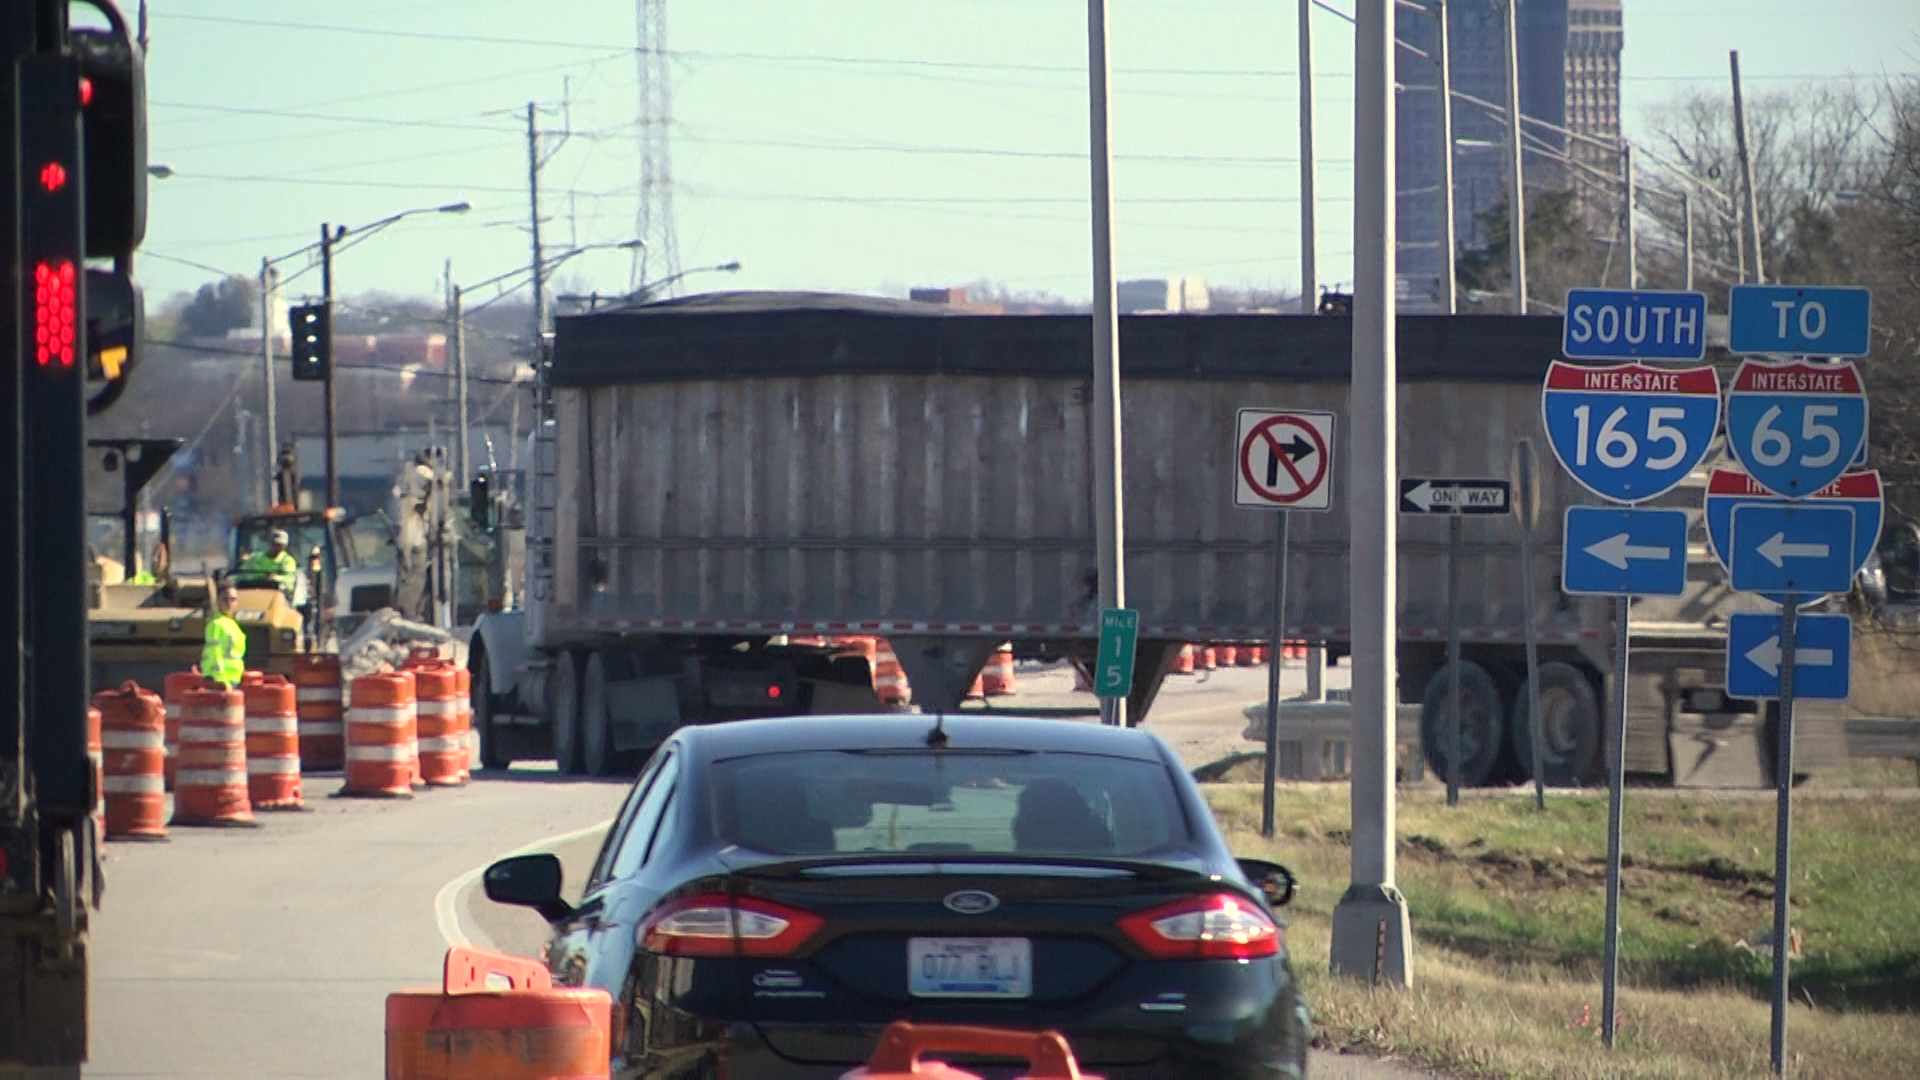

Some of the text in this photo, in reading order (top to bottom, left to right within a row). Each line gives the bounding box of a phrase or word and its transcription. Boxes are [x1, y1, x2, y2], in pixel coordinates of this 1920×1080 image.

[1571, 304, 1697, 345] SOUTH
[1771, 301, 1827, 340] TO
[1584, 372, 1680, 391] INTERSTATE
[1752, 373, 1844, 391] INTERSTATE
[1573, 404, 1688, 470] 165
[1751, 404, 1841, 468] 65
[1468, 491, 1500, 504] WAY
[1104, 616, 1135, 628] MILE
[1106, 665, 1121, 687] 5
